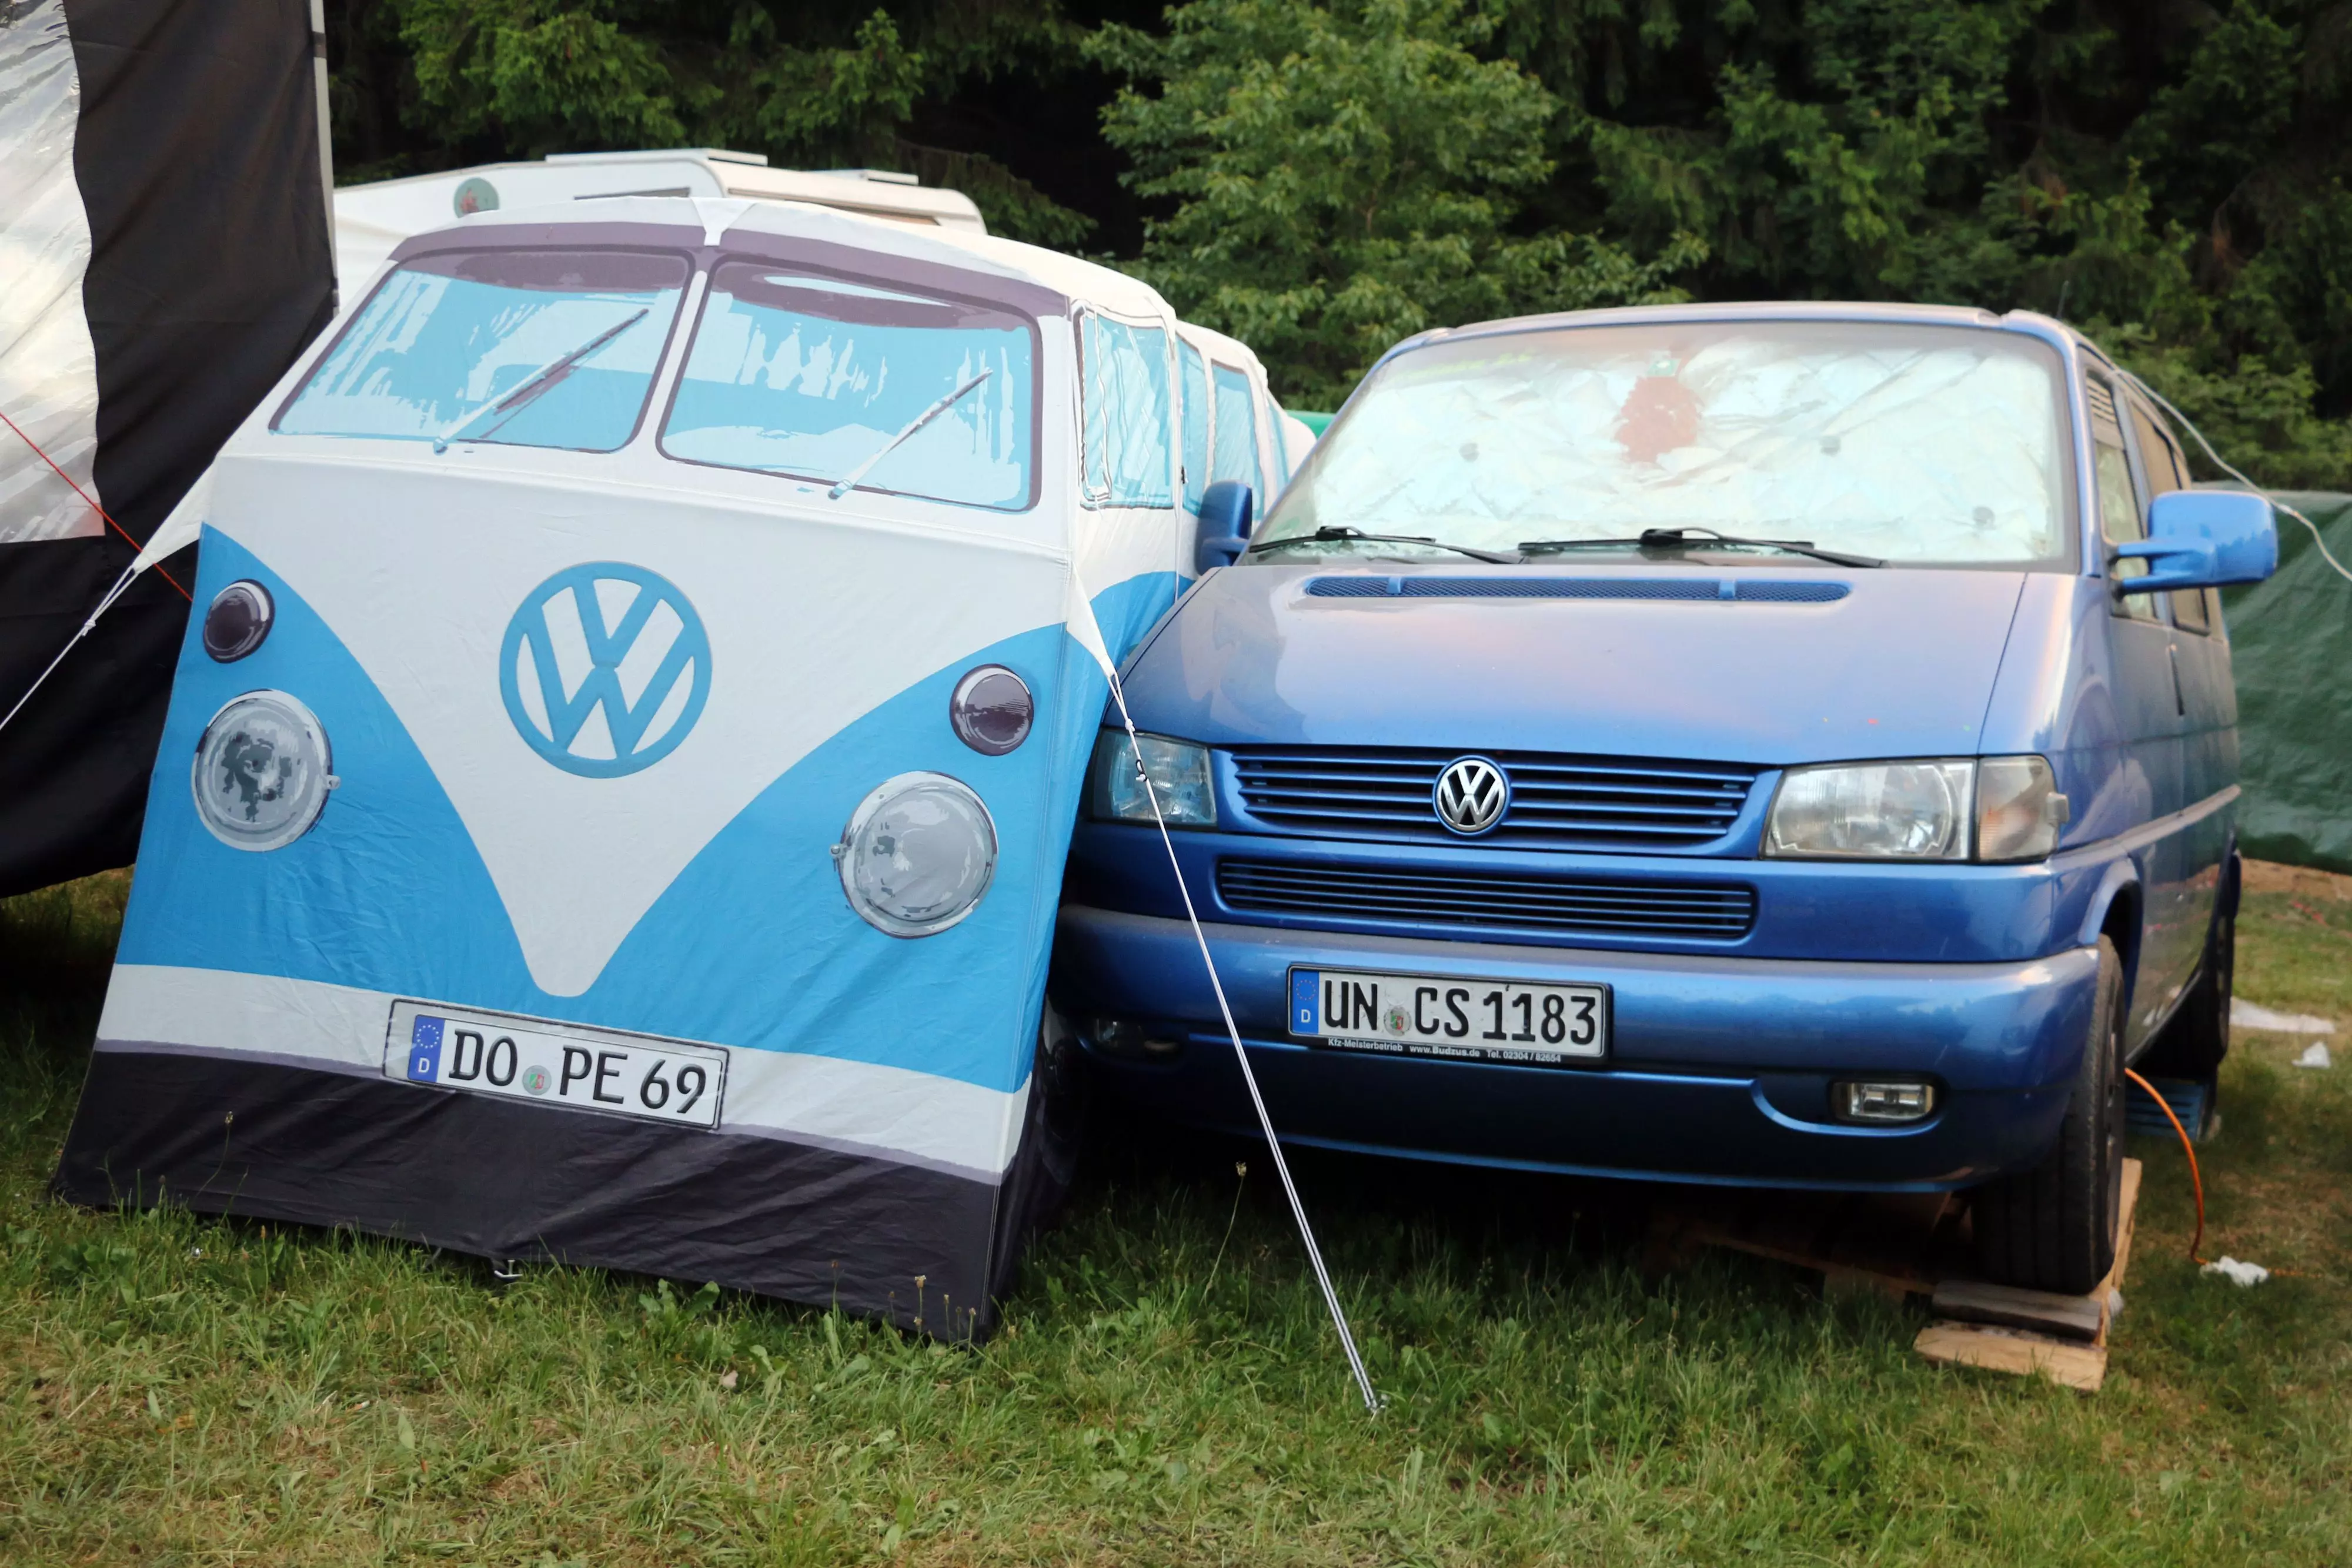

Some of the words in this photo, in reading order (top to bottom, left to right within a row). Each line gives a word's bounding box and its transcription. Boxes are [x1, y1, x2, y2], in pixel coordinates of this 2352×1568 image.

[1300, 1009, 1311, 1024] D
[1324, 979, 1378, 1031] UN
[1415, 987, 1470, 1038] CS
[1482, 991, 1596, 1045] 1183
[1328, 1038, 1404, 1052] Kfz-Meisterbetrieb
[417, 1057, 430, 1074] D
[449, 1028, 518, 1086] DO
[559, 1045, 629, 1104] PE
[640, 1059, 707, 1114] 69
